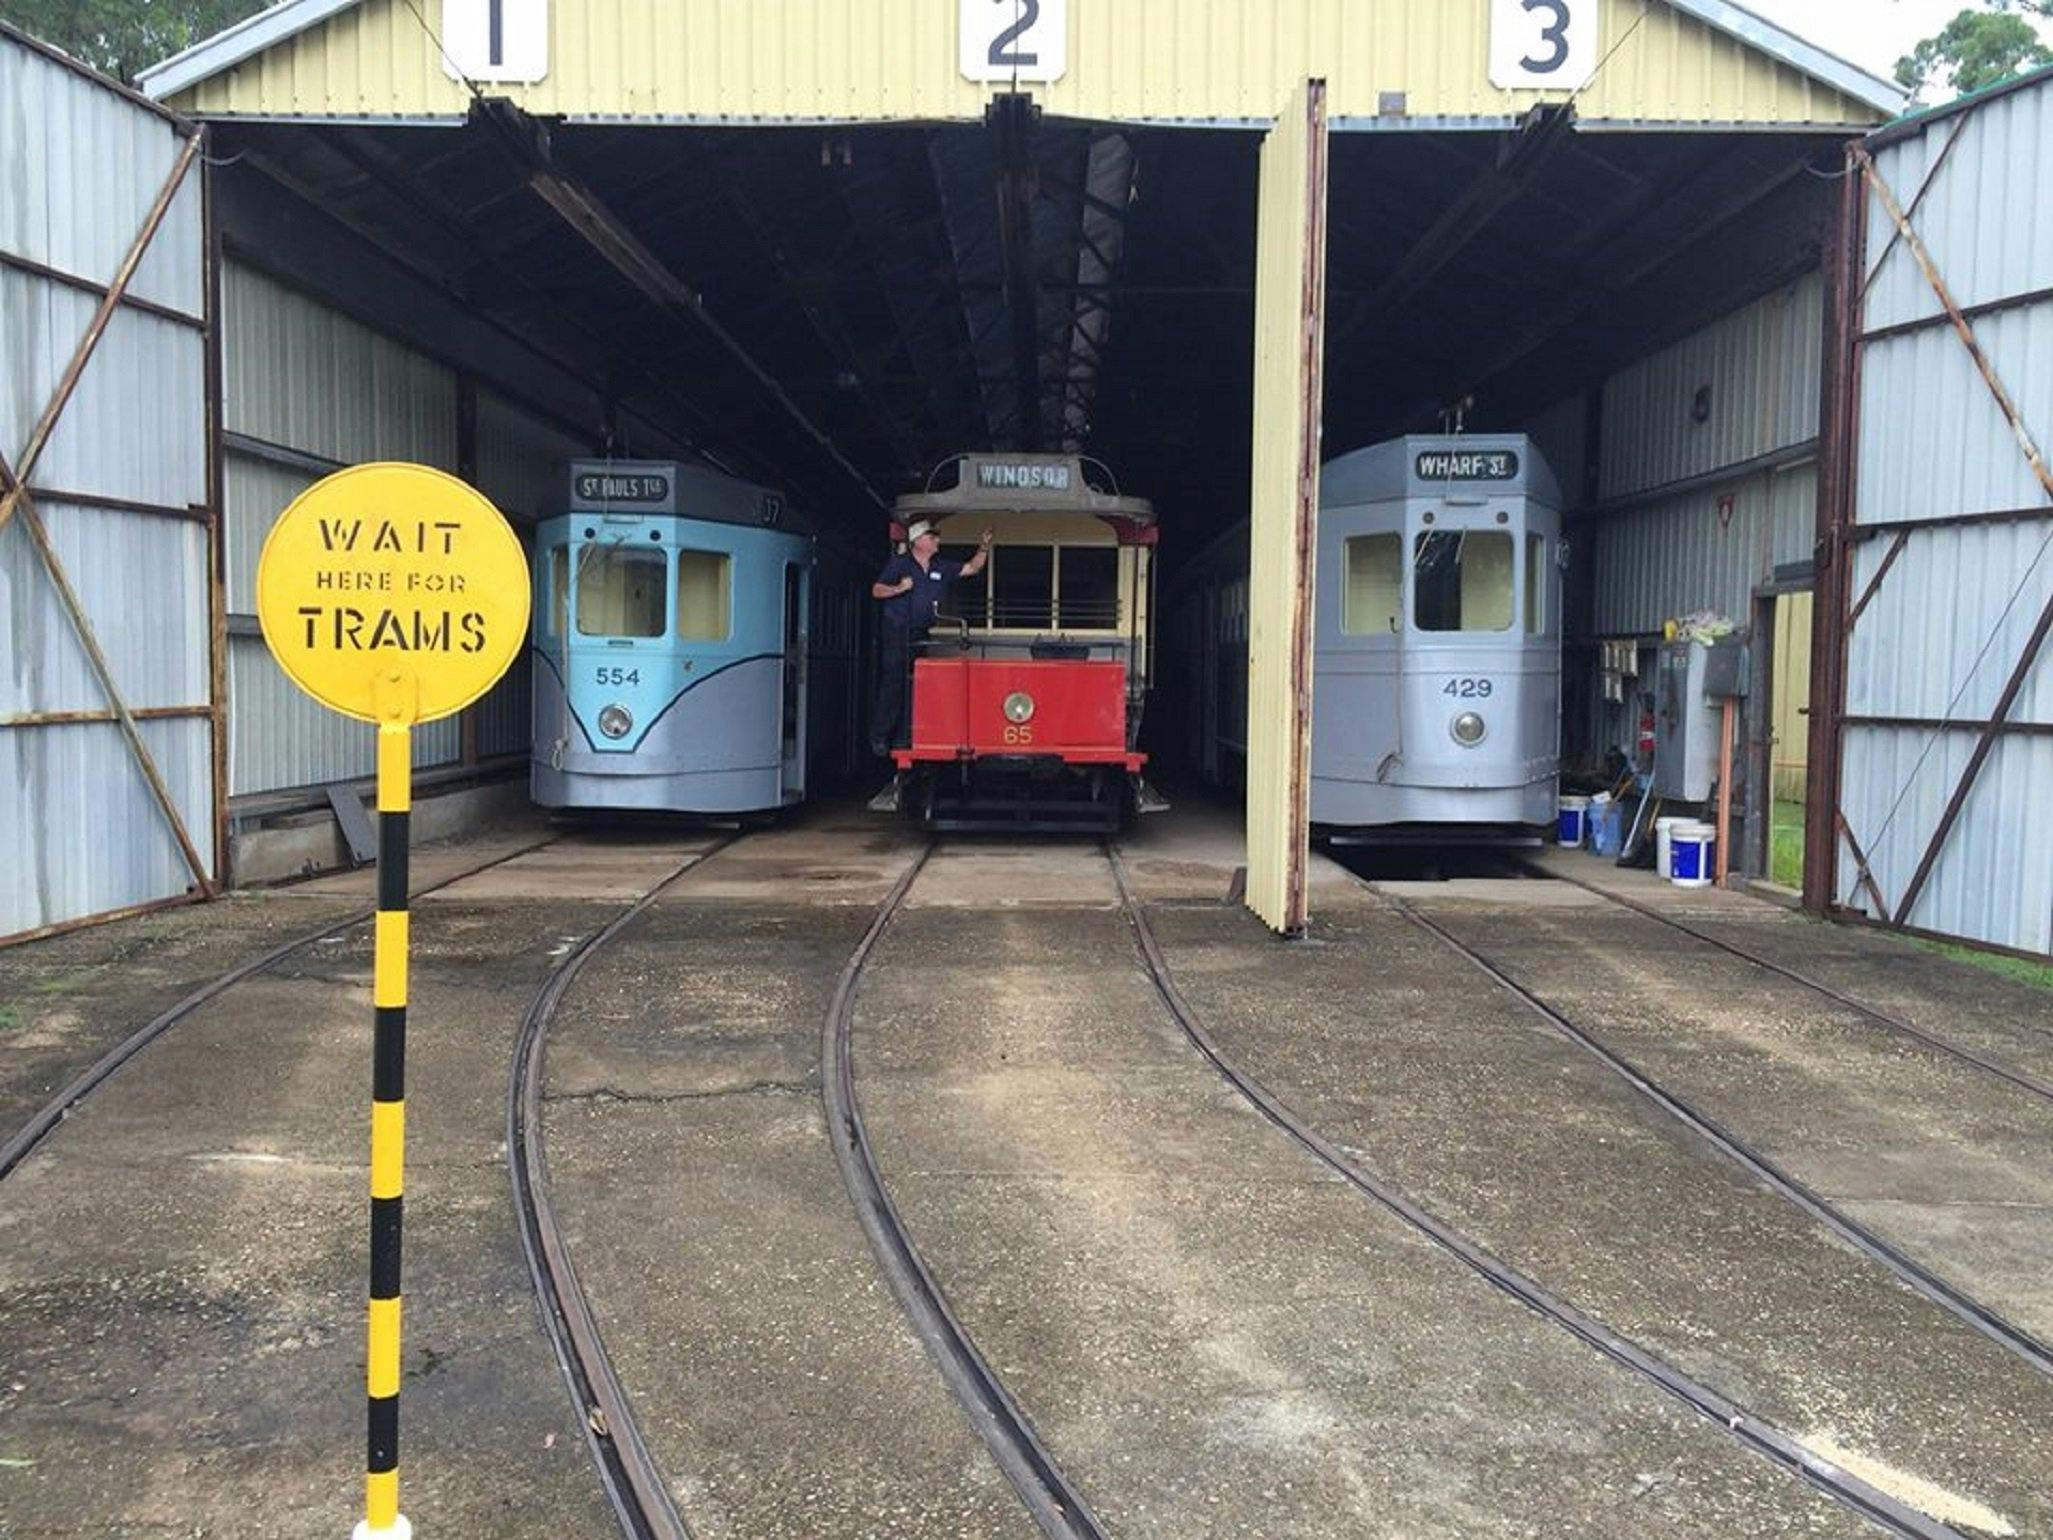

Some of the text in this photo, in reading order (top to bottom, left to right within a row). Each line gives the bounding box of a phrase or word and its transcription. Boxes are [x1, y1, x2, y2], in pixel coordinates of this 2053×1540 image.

[987, 0, 1039, 66] 2
[1518, 0, 1570, 74] 3
[1420, 454, 1482, 476] WHARF
[319, 519, 461, 554] WAIT
[316, 571, 466, 594] HERE FOR
[298, 606, 487, 653] TRAMS
[596, 666, 640, 686] 554
[1443, 678, 1492, 698] 429
[1004, 726, 1032, 744] 65
